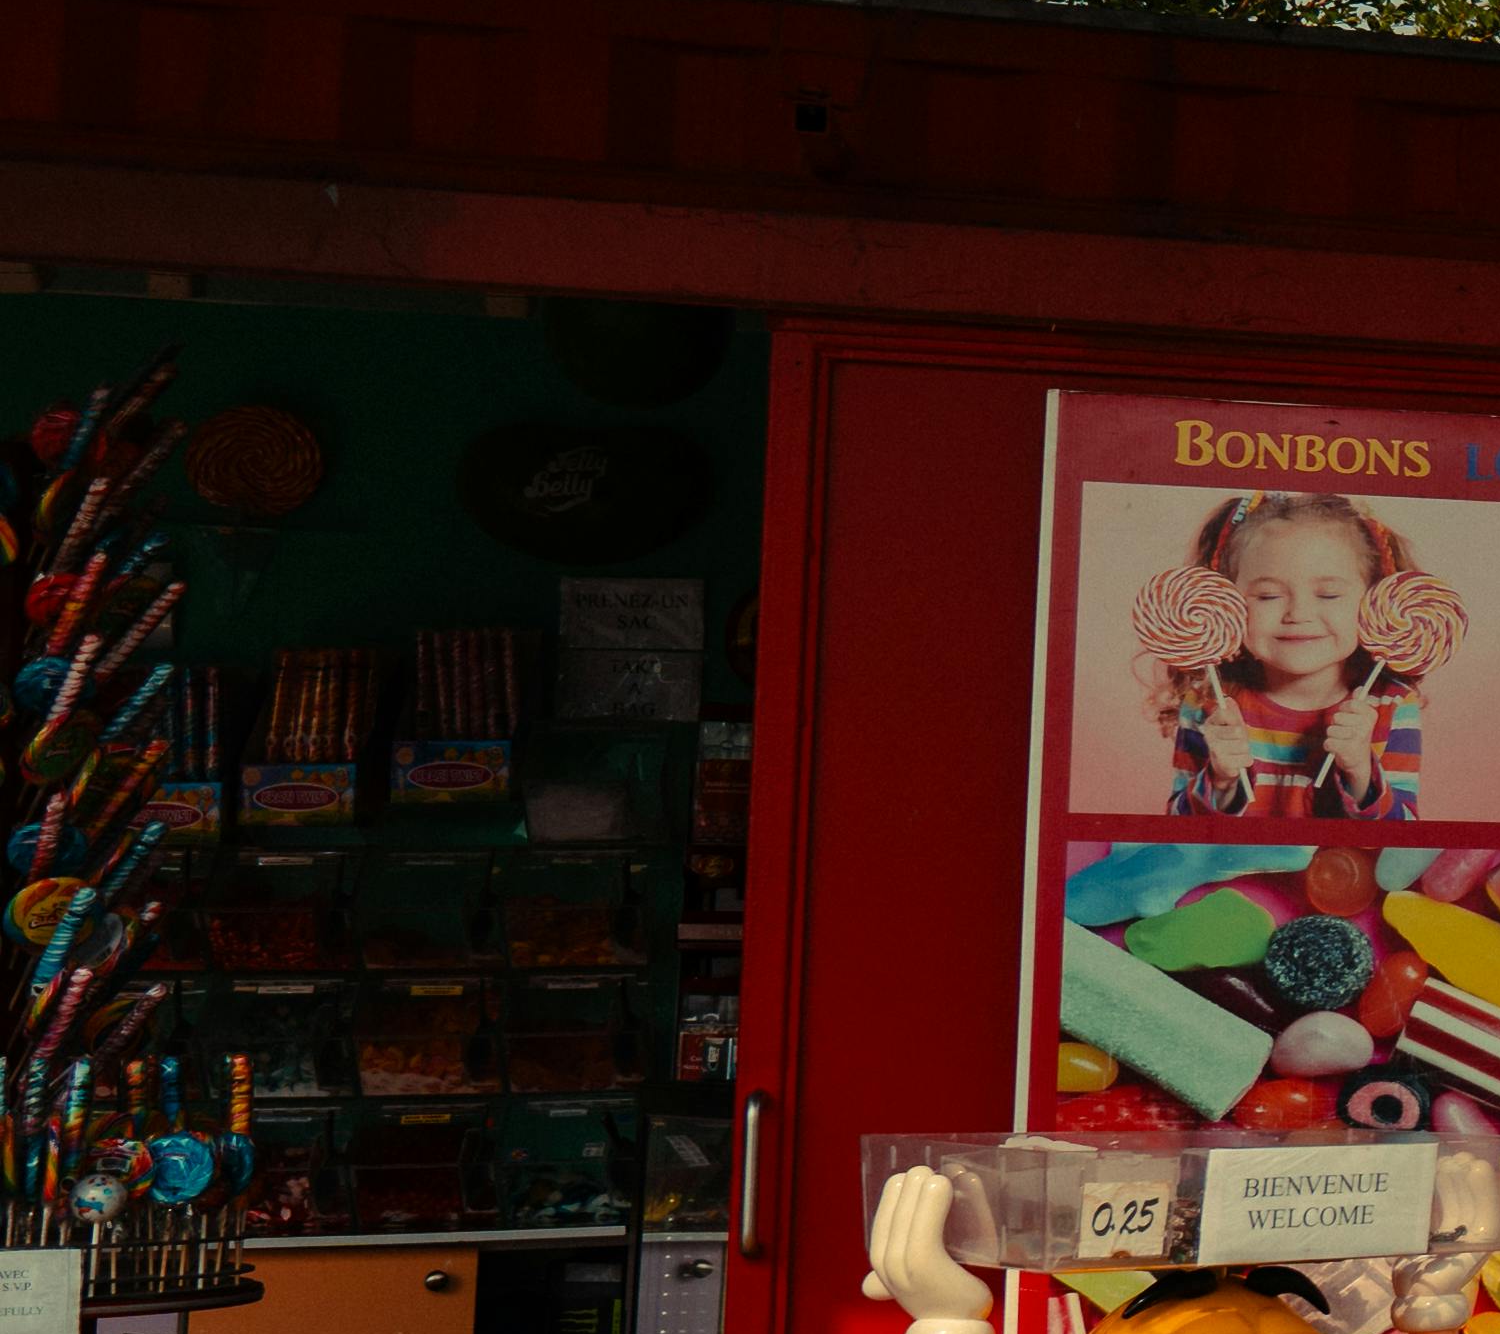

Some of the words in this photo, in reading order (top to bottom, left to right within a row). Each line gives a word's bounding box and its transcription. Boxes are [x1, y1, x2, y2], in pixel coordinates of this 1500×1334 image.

[1173, 418, 1431, 478] BONBONS
[576, 593, 689, 610] PRENEZ-UN
[617, 615, 656, 630] SAC
[1243, 1171, 1390, 1199] BIENVENUE
[1091, 1197, 1160, 1237] 0.25
[1248, 1204, 1376, 1230] WELCOME
[0, 1305, 44, 1316] EFULLY
